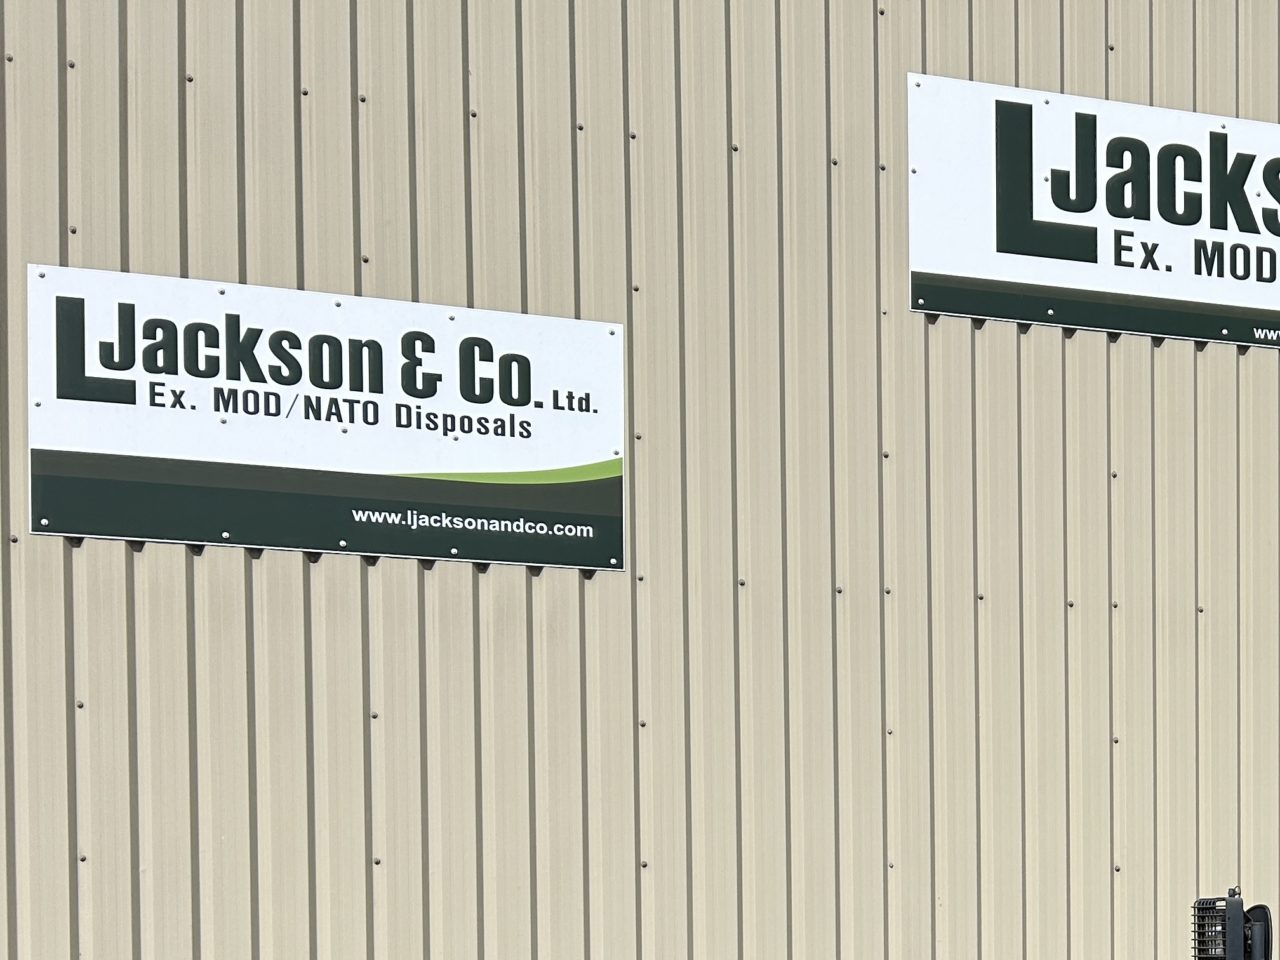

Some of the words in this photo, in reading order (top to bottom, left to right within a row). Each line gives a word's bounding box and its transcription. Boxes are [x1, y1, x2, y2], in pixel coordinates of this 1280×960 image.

[1114, 230, 1172, 272] Ex.
[401, 331, 442, 399] &
[459, 337, 543, 408] Co.
[553, 390, 597, 413] Ltd.
[149, 381, 197, 411] Ex.
[213, 386, 379, 426] MOD/NATO
[395, 403, 531, 438] Disposals
[351, 509, 594, 538] www.ljacksonandco.com
